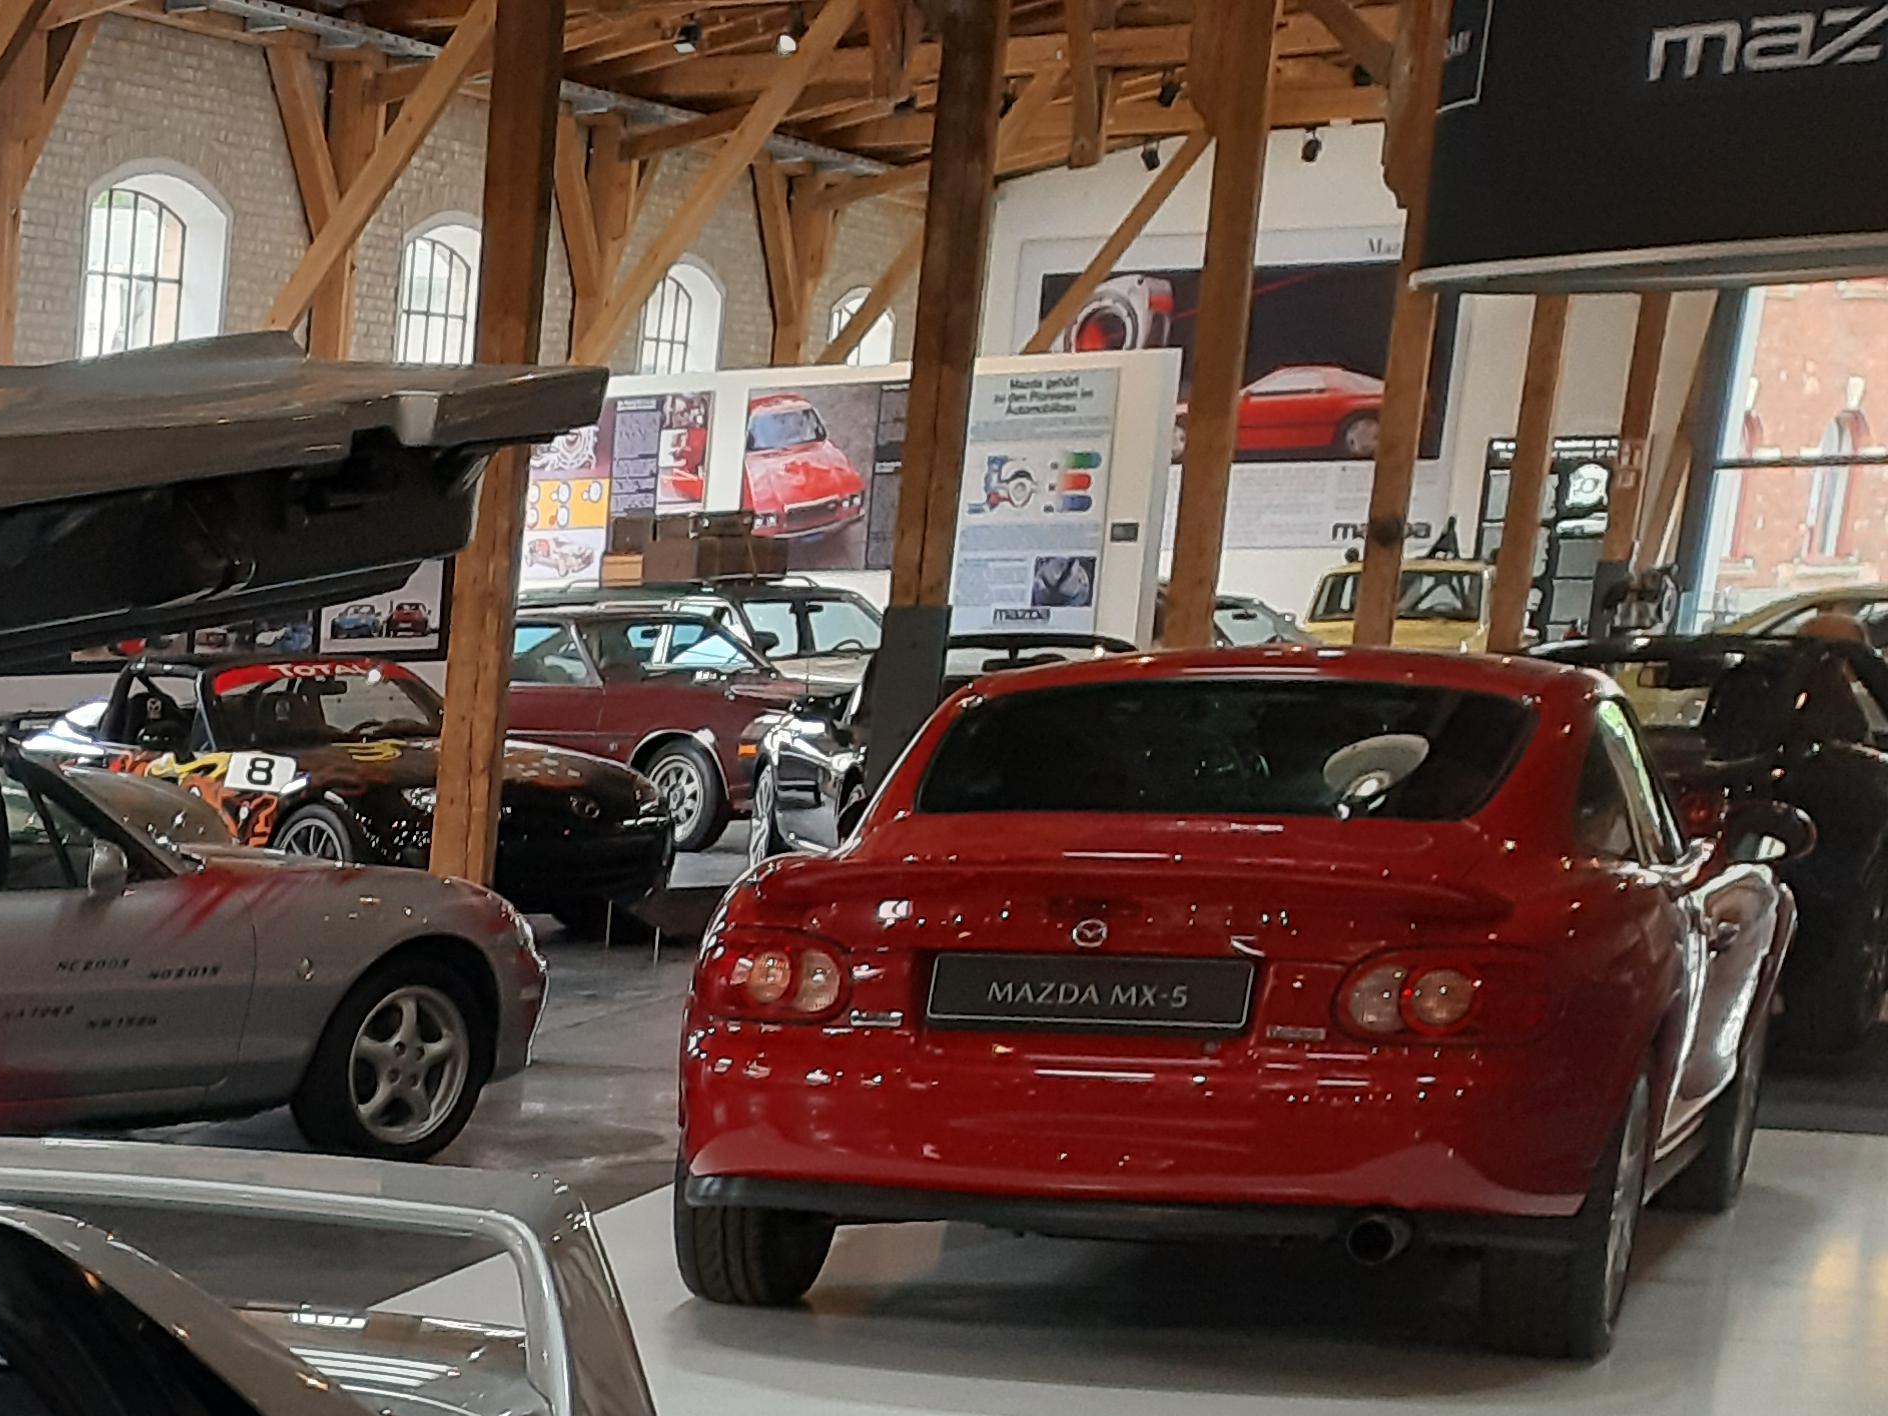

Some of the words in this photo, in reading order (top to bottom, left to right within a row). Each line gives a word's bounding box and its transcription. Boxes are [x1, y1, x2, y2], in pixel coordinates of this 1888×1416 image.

[268, 663, 368, 679] TOTAL
[246, 757, 275, 785] 8
[987, 981, 1101, 1006] MAZDA
[1110, 984, 1188, 1009] MX-5
